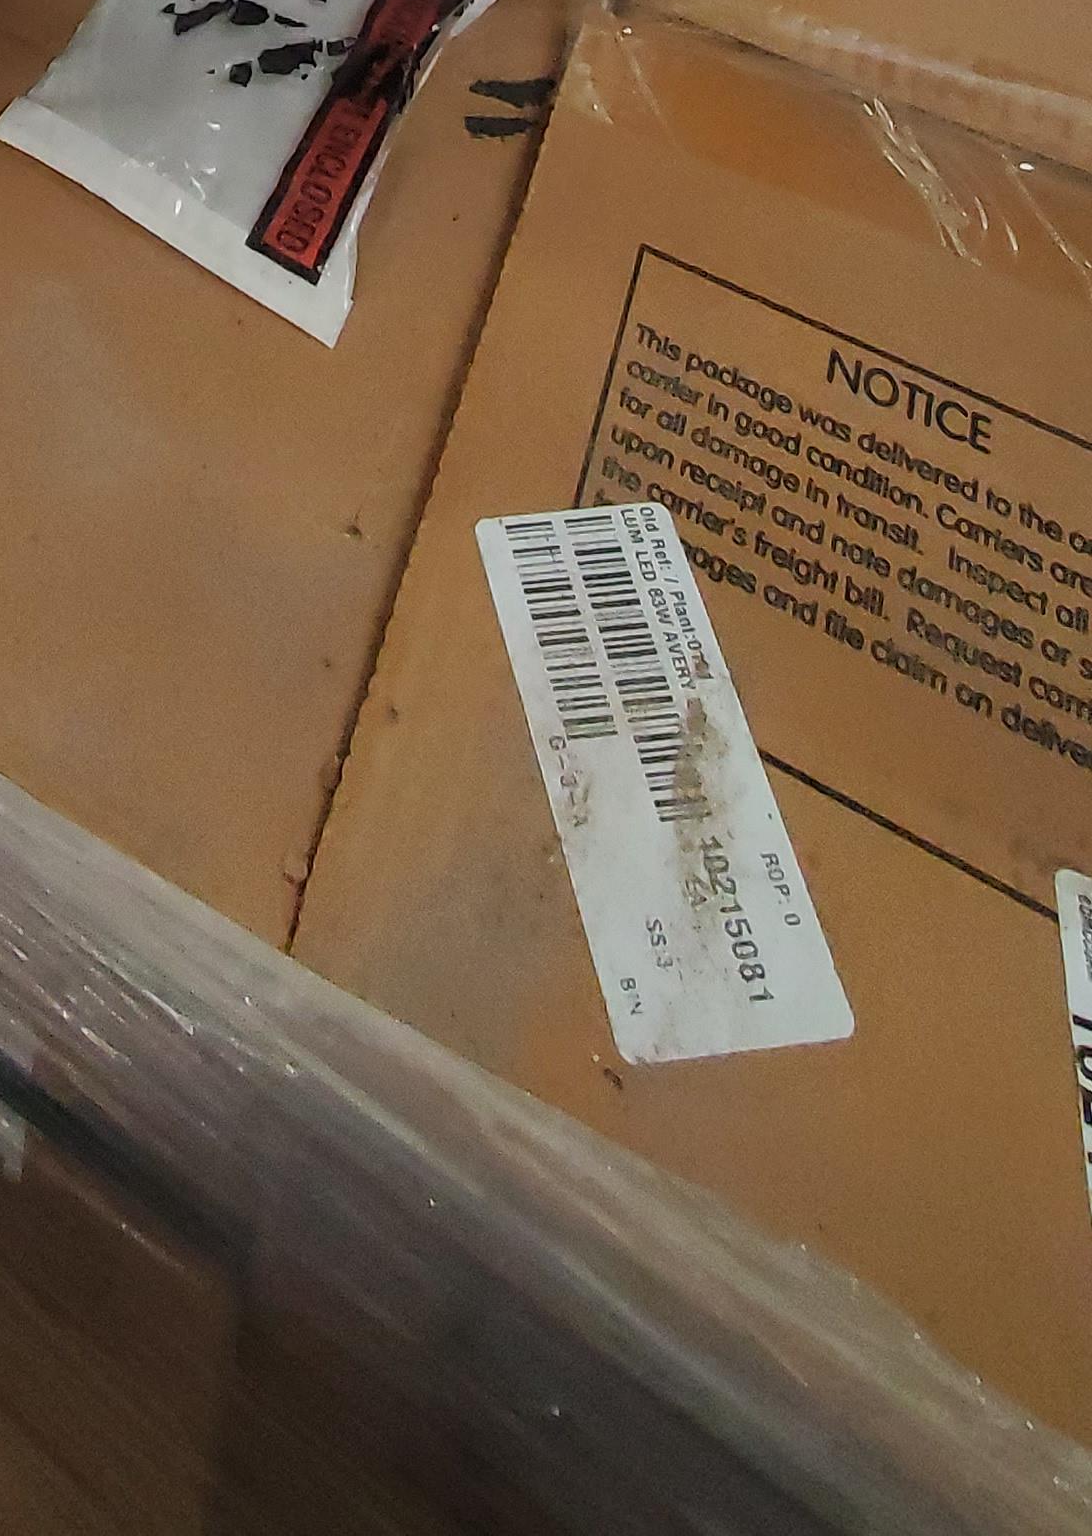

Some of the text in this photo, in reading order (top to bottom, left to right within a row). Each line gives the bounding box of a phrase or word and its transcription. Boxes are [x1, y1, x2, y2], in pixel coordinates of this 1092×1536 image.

[627, 360, 704, 408] carrier
[708, 392, 729, 422] in
[735, 411, 802, 457] good
[806, 445, 929, 520] condition.
[936, 502, 1044, 573] Carriers
[637, 322, 681, 361] This
[685, 353, 792, 414] package
[799, 403, 852, 443] was
[857, 431, 979, 503] delivered
[986, 487, 1012, 517] to
[1018, 502, 1063, 543] the
[826, 348, 992, 455] NOTICE
[610, 424, 675, 470] upon
[680, 458, 767, 516] receipt
[771, 505, 826, 545] and
[831, 533, 891, 578] note
[897, 565, 1035, 650] damages
[1041, 638, 1072, 667] or
[620, 386, 653, 419] for
[656, 410, 688, 437] all
[690, 426, 801, 494] damage
[806, 477, 830, 509] in
[836, 492, 925, 556] transit.
[948, 545, 1048, 616] Inspect
[639, 506, 659, 533] Old
[650, 538, 672, 571] Ref:
[620, 508, 644, 544] LUM
[635, 550, 657, 581] LED
[662, 630, 697, 690] AVERY
[754, 529, 839, 594] freight
[844, 575, 891, 621] bill.
[906, 606, 1023, 688] Request
[763, 584, 819, 627] and
[825, 608, 865, 651] file
[955, 682, 993, 719] on
[700, 835, 775, 1003] 10215081
